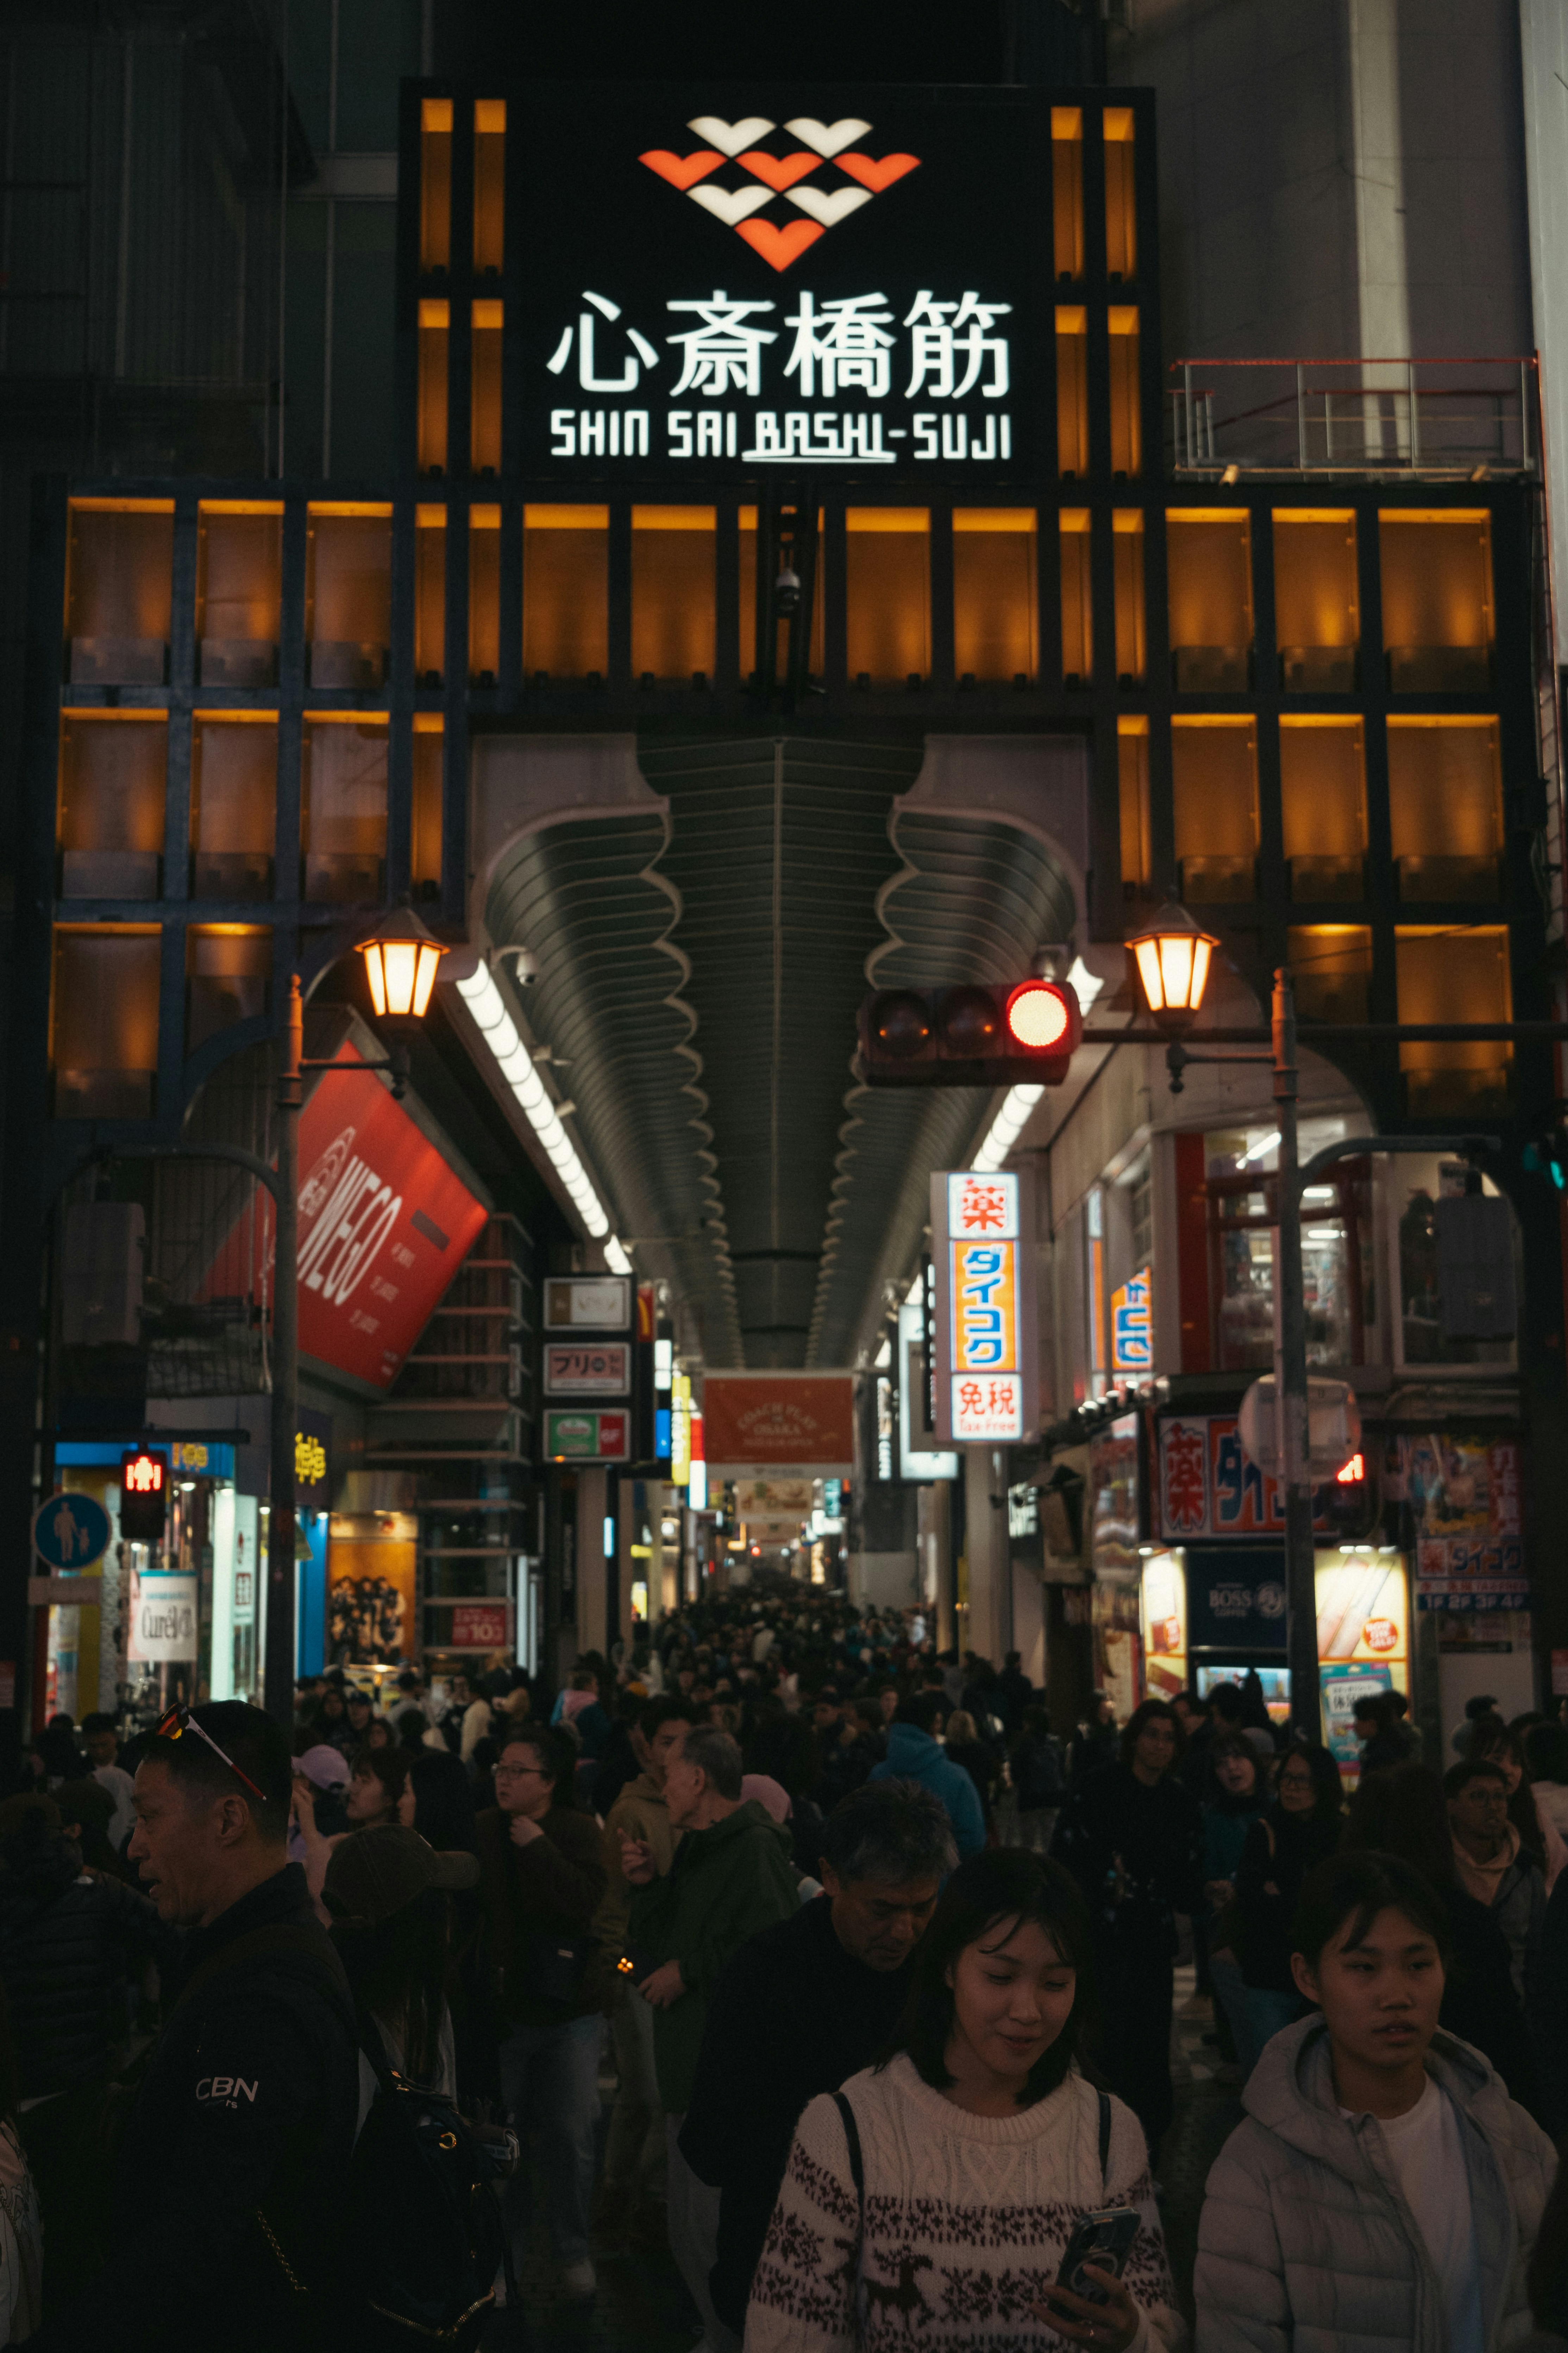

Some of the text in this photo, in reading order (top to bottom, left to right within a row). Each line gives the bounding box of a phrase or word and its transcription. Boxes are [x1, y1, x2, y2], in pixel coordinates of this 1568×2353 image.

[546, 290, 1013, 399] 心斎橋筋
[551, 410, 650, 456] SHIN
[668, 411, 737, 458] SAI
[962, 1179, 1005, 1230] 薬
[298, 1155, 403, 1306] WEGO
[964, 1245, 1003, 1364] ダイコク
[959, 1381, 1015, 1416] 免税
[1167, 1423, 1203, 1528] 薬
[1209, 1589, 1252, 1608] BOSS
[196, 2076, 259, 2102] CBN
